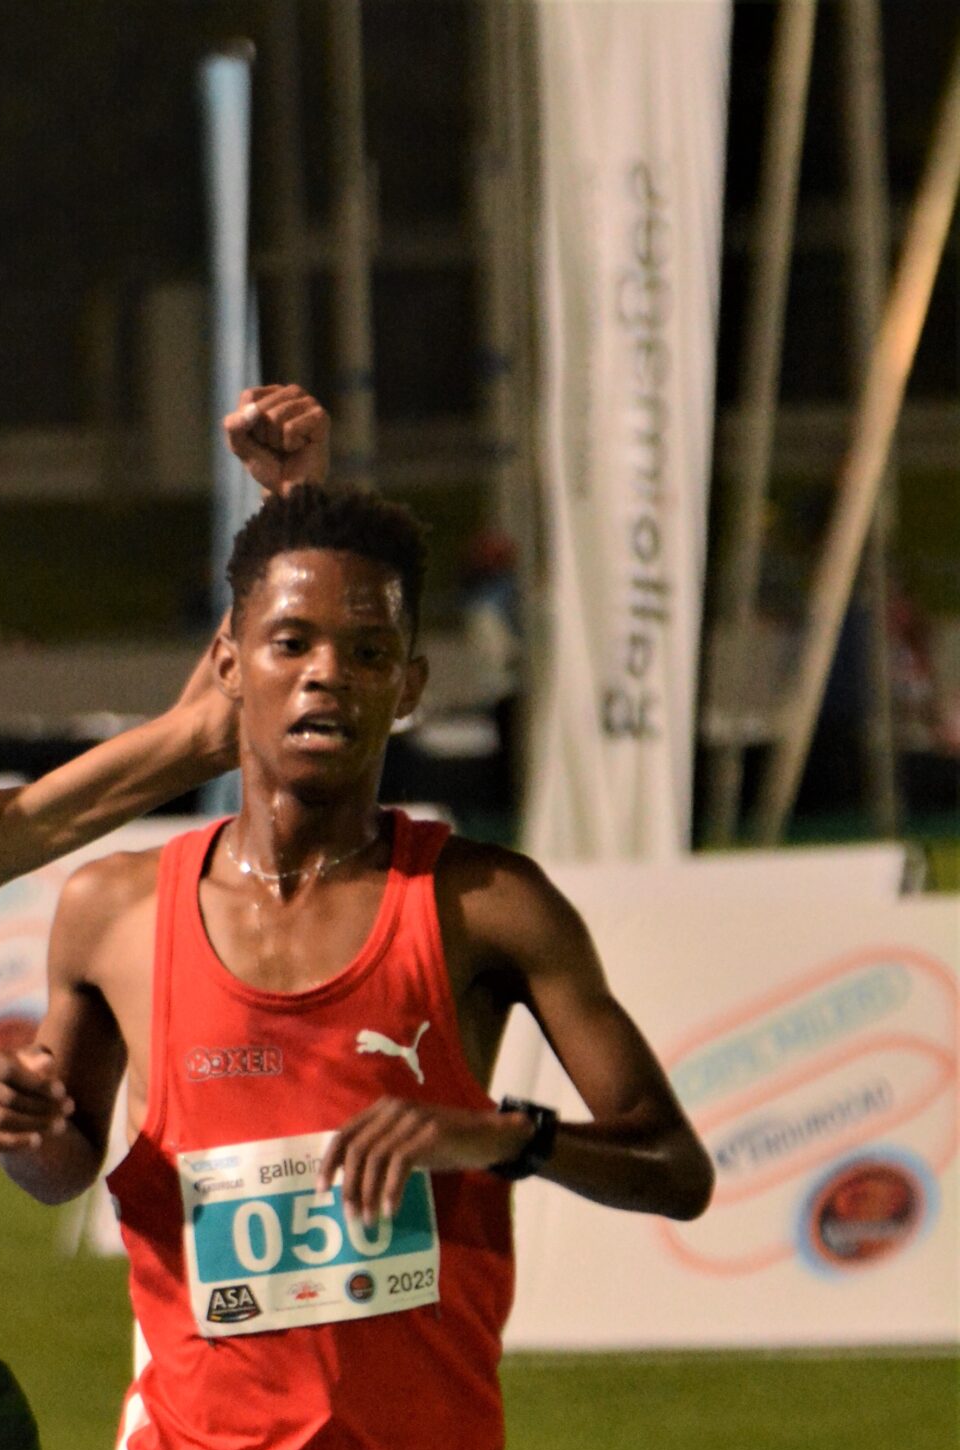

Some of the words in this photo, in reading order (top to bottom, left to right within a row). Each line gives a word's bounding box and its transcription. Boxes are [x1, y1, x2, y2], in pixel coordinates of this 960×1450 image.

[184, 1047, 283, 1082] BOXER
[387, 1267, 435, 1295] 2023
[211, 1287, 256, 1311] ASA
